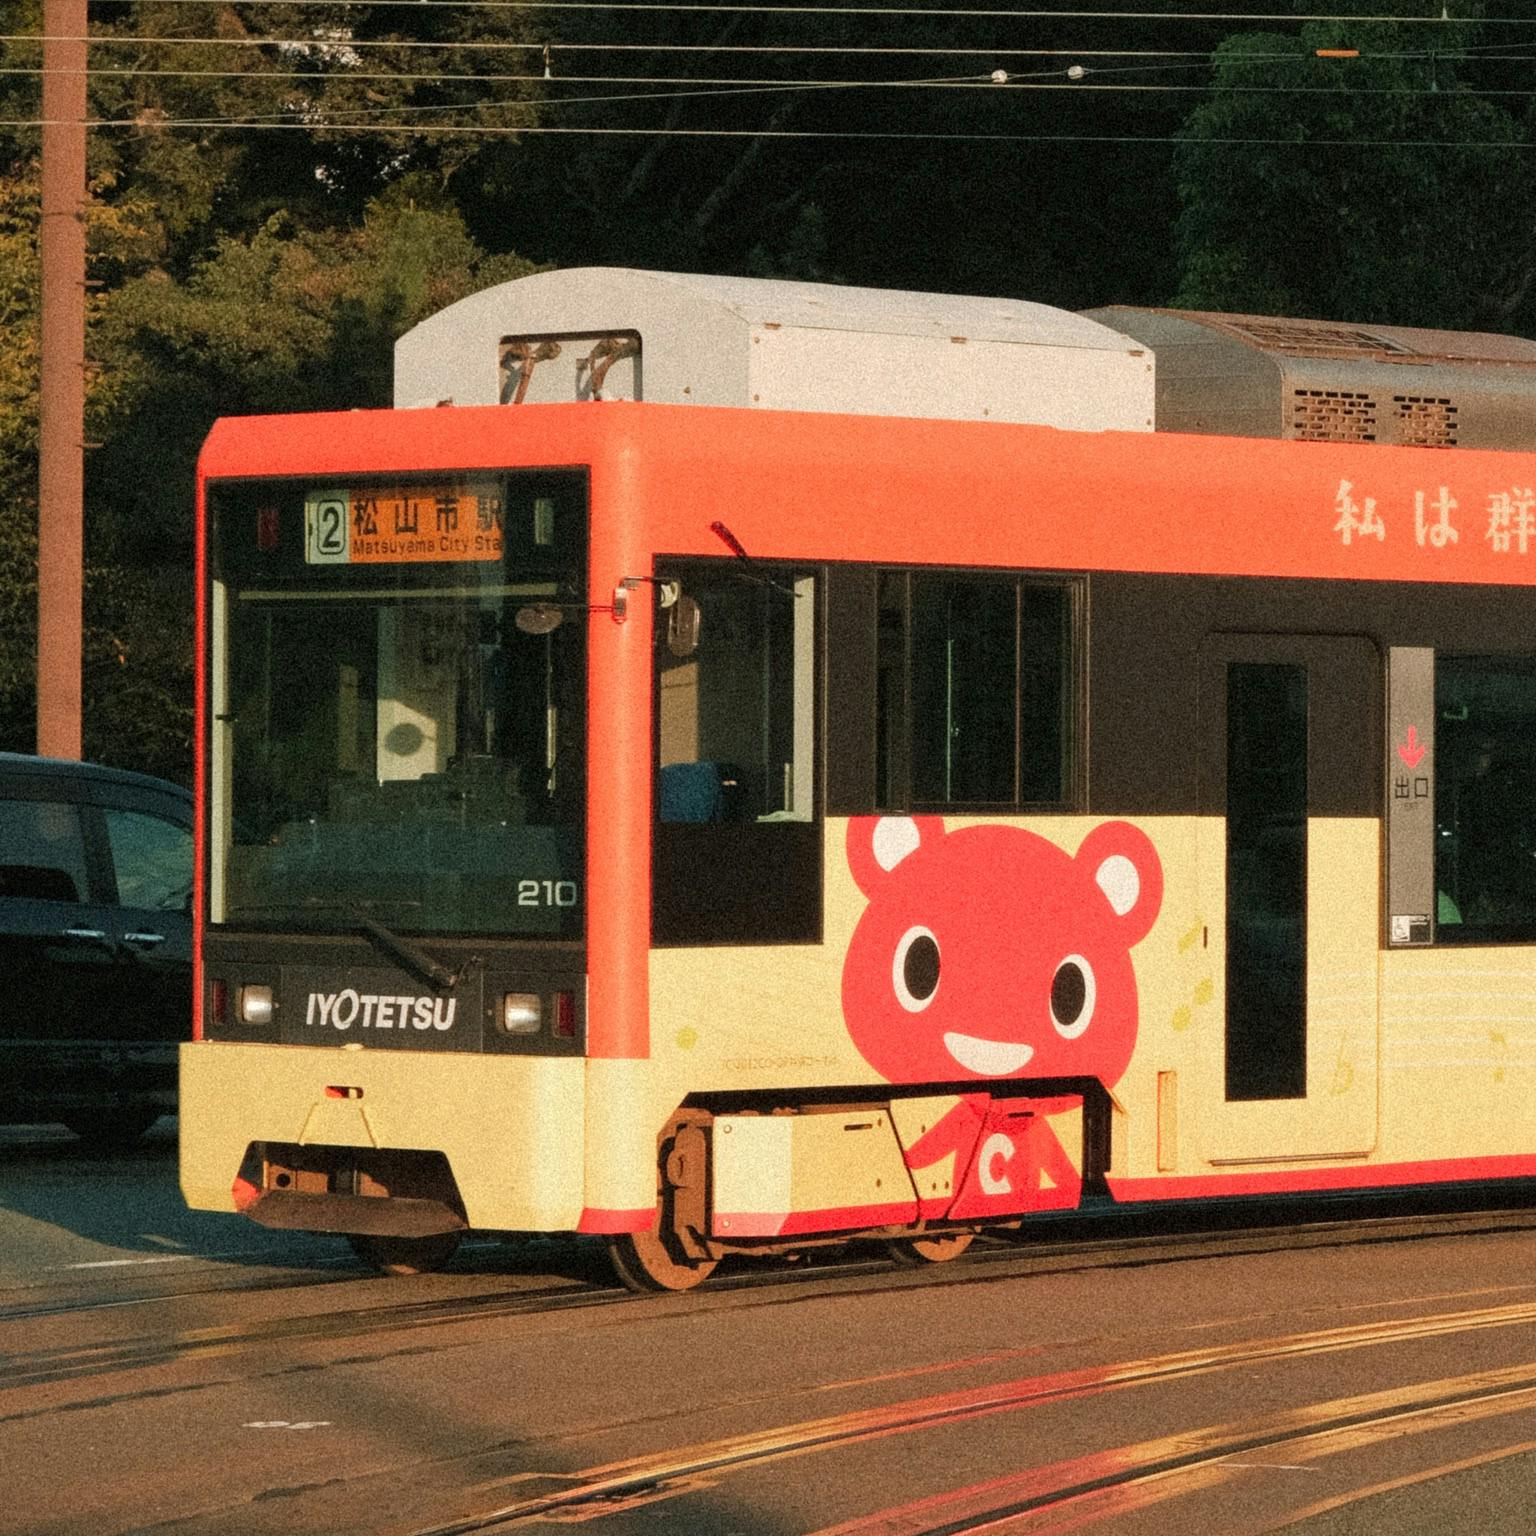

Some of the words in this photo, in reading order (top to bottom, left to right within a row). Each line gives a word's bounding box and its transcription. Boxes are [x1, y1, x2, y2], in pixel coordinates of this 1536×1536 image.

[322, 506, 341, 548] 2
[353, 495, 502, 536] 松山市駅
[352, 539, 435, 556] Matsuyama
[439, 536, 469, 553] City
[1395, 776, 1428, 799] 出口
[517, 880, 577, 907] 210
[306, 988, 456, 1031] IYOTETSU
